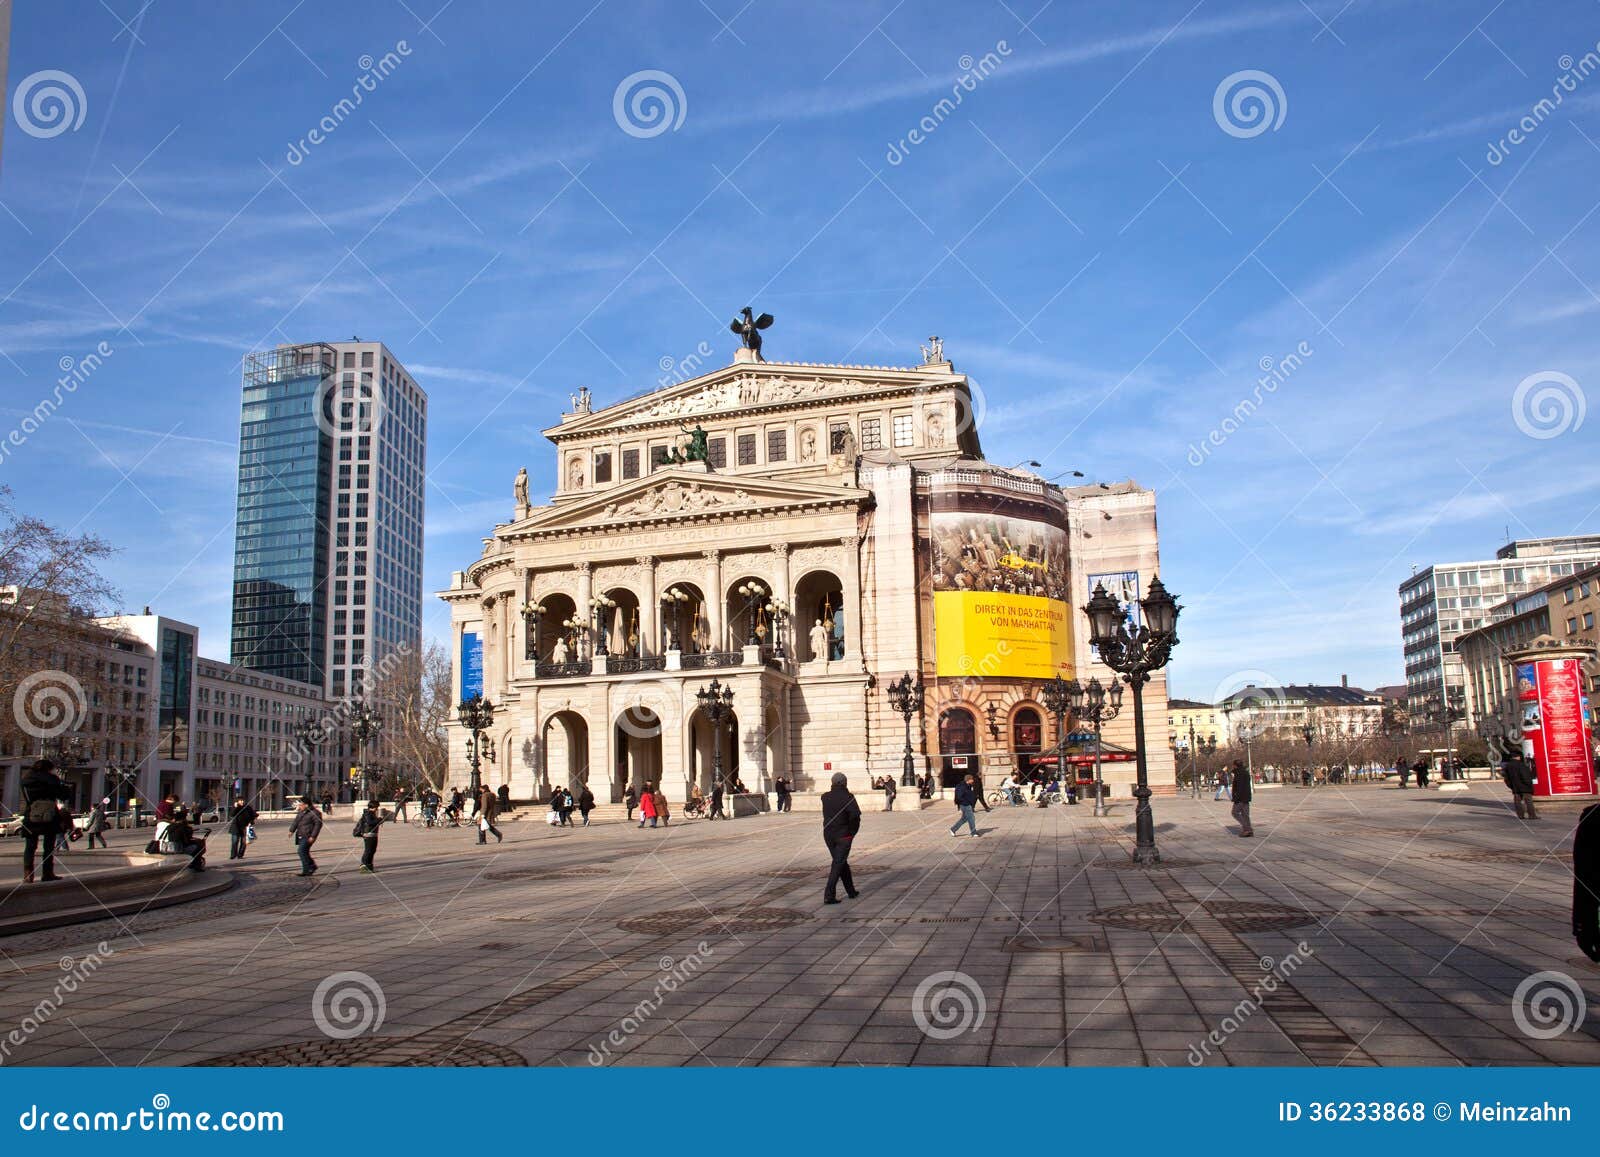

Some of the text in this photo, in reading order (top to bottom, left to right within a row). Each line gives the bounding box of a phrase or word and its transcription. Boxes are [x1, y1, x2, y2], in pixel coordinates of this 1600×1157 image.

[975, 604, 1064, 622] DIREKT IN DAS ZENTRUM
[991, 617, 1009, 627] VON
